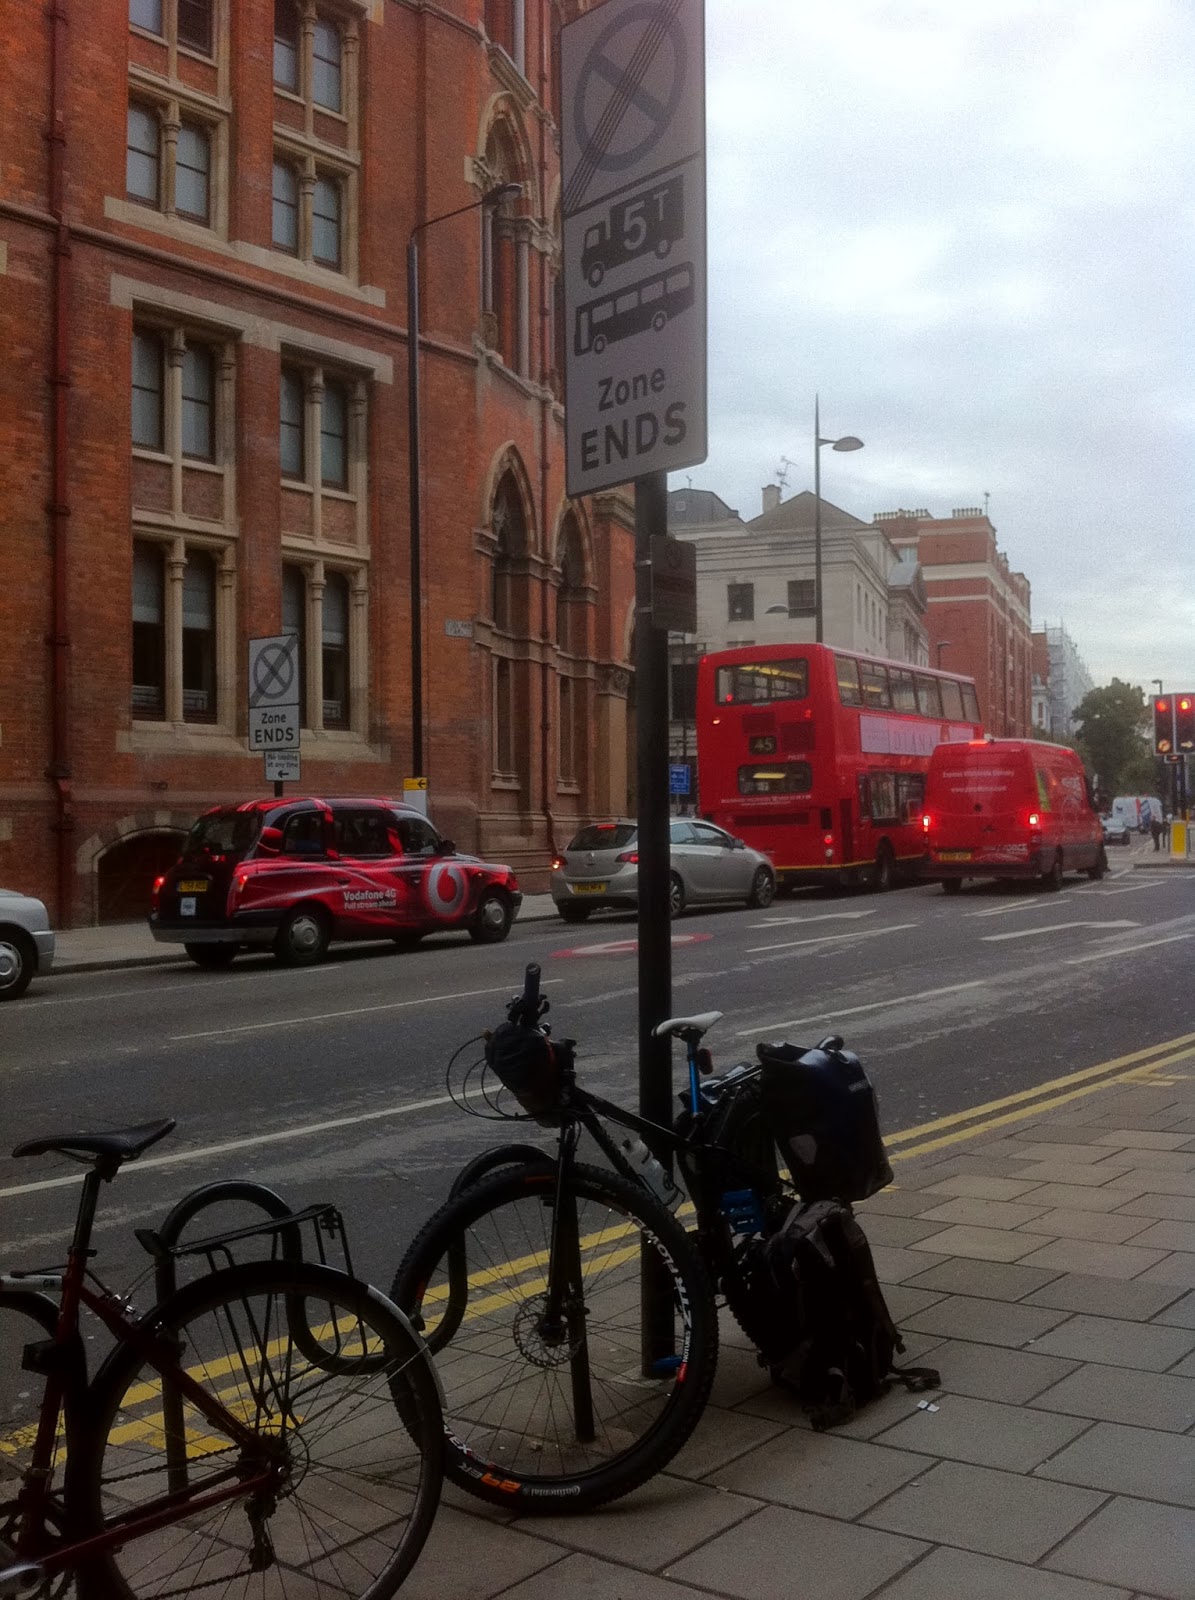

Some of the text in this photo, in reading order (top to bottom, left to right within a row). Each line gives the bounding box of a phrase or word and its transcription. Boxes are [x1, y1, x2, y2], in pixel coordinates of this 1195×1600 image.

[598, 368, 664, 412] Zone
[581, 402, 687, 471] ENDS
[261, 713, 286, 724] Zone
[255, 727, 294, 744] ENDS
[754, 737, 774, 751] 45
[343, 888, 397, 901] Vodafone 4G
[643, 1229, 680, 1274] FLOW
[674, 1276, 692, 1330] ZTR
[530, 1485, 581, 1497] Continental
